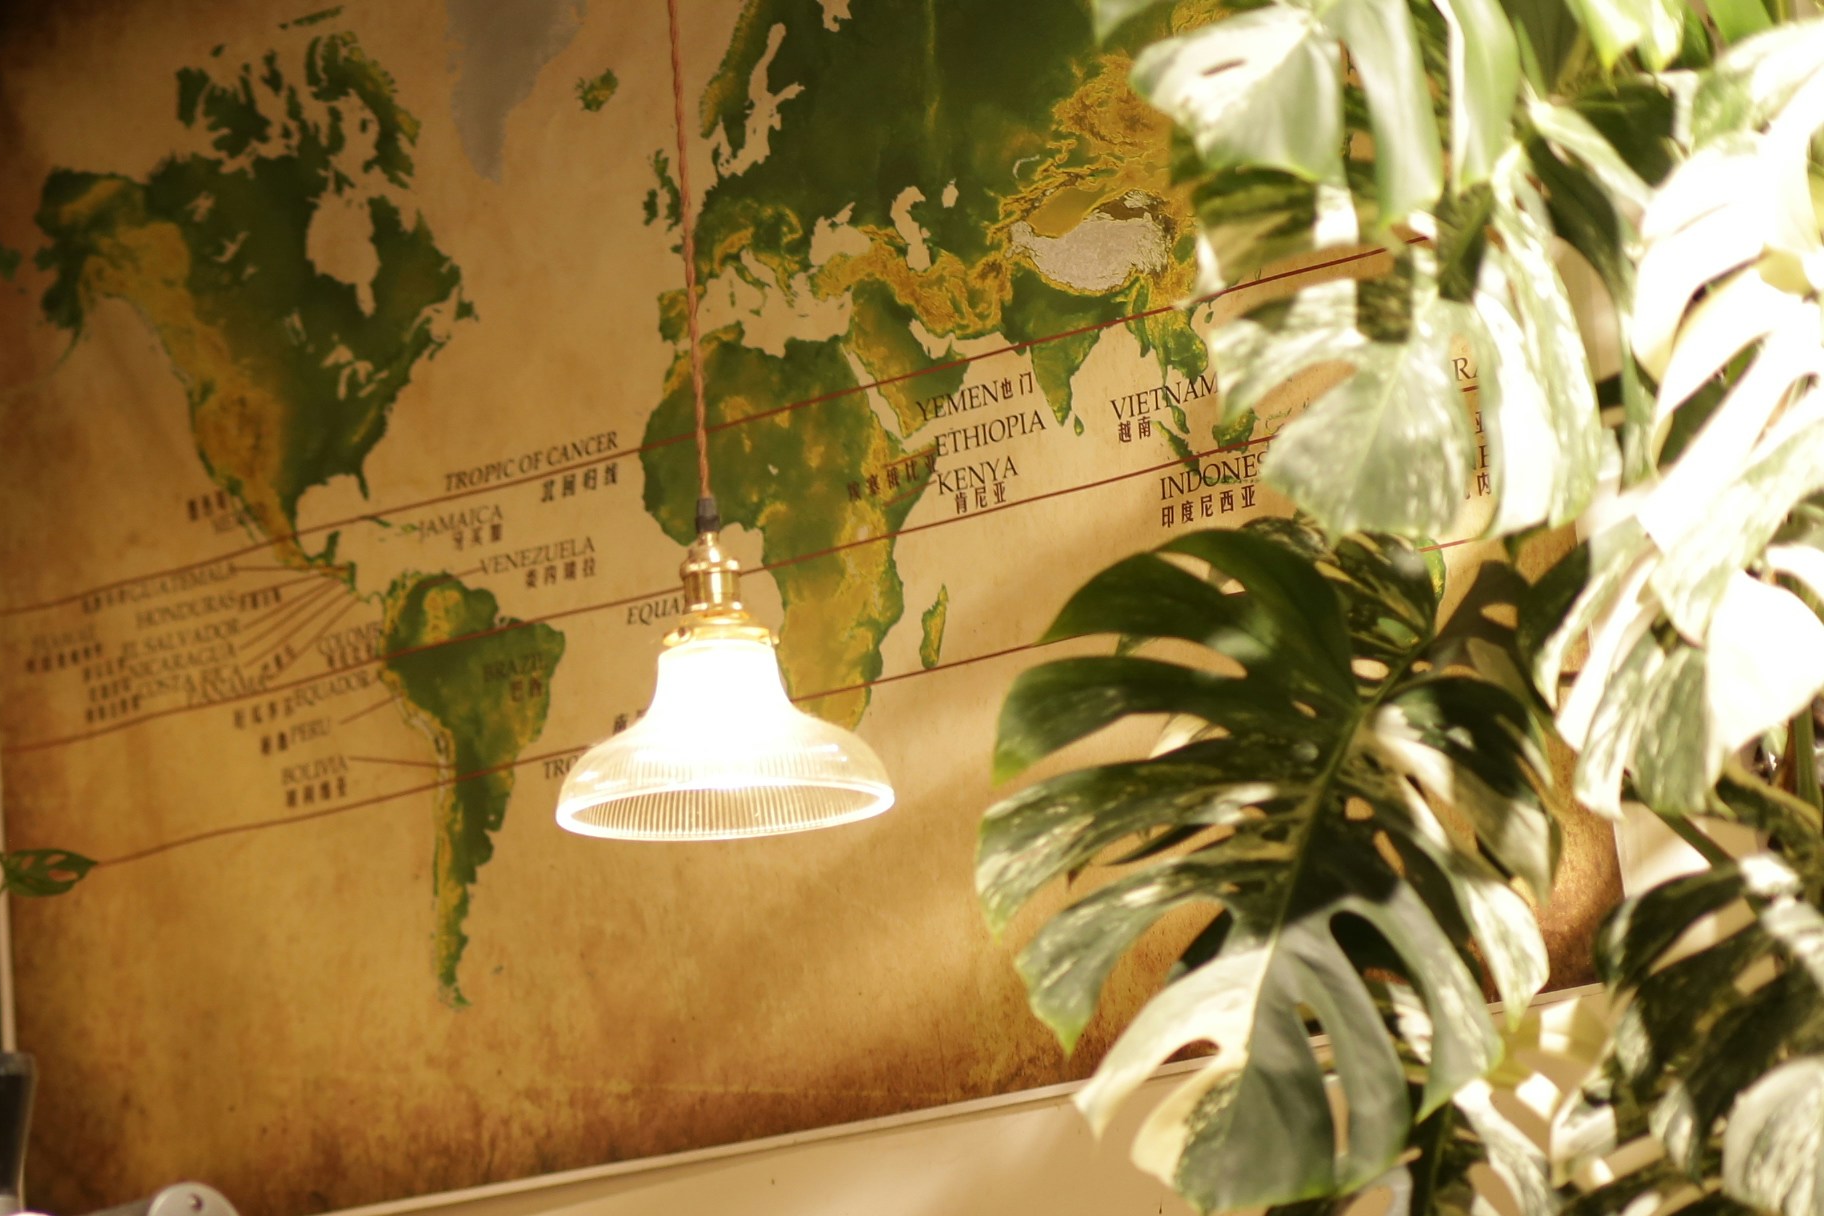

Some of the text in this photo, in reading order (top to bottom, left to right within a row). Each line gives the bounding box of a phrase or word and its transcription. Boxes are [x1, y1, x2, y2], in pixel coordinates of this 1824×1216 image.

[916, 371, 1034, 422] YEMEN 也门
[1109, 371, 1220, 421] VIETNAM
[933, 409, 1047, 457] ETHIOPIA
[1117, 415, 1152, 444] 越南
[443, 430, 619, 493] TROPIC OF CANCER
[936, 455, 1019, 496] KENYA
[1159, 450, 1269, 501] INDONES
[954, 480, 1007, 515] 肯尼亚
[1161, 484, 1257, 529] 印度尼西亚
[479, 535, 596, 576] VENEZUELA
[626, 594, 688, 626] EQUA
